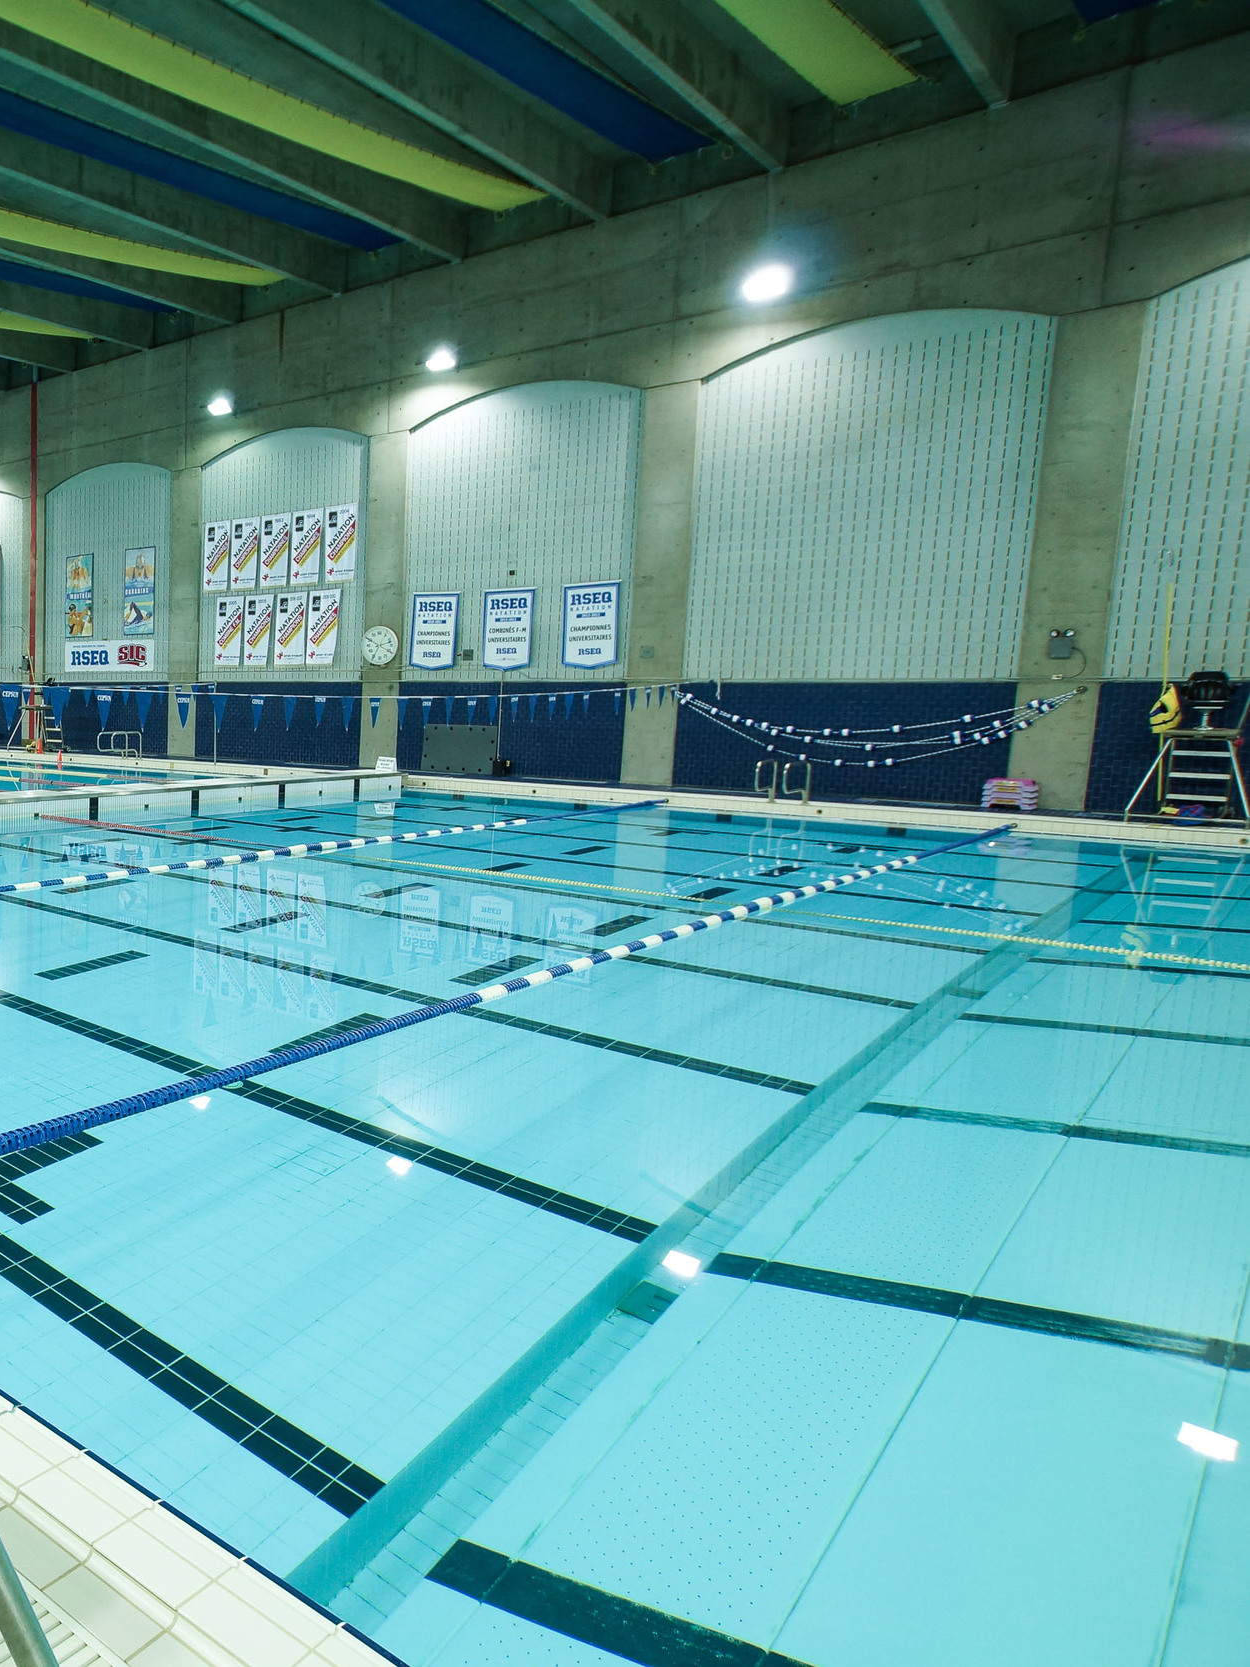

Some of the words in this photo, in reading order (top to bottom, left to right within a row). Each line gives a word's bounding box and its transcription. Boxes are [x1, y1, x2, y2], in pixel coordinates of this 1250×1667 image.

[233, 526, 258, 558] NATATION
[263, 522, 288, 556] NATATION
[294, 518, 320, 552] NATATION
[327, 514, 355, 549] NATATION
[329, 526, 355, 560] CHAMPIONS
[418, 602, 452, 612] RSEQ
[490, 598, 528, 610] RSEQ
[570, 592, 612, 606] RSEQ
[218, 606, 241, 636] NATATION
[247, 604, 271, 635] NATATION
[278, 602, 304, 634] NATATION
[279, 615, 303, 644] CHAMPIONS
[310, 599, 337, 632] NATATION
[570, 624, 612, 632] CHAMPIONNES
[118, 645, 146, 660] SIC
[569, 634, 612, 642] UNIVERSITAIRES
[578, 648, 602, 656] RSEQ
[71, 650, 109, 665] RSEQ
